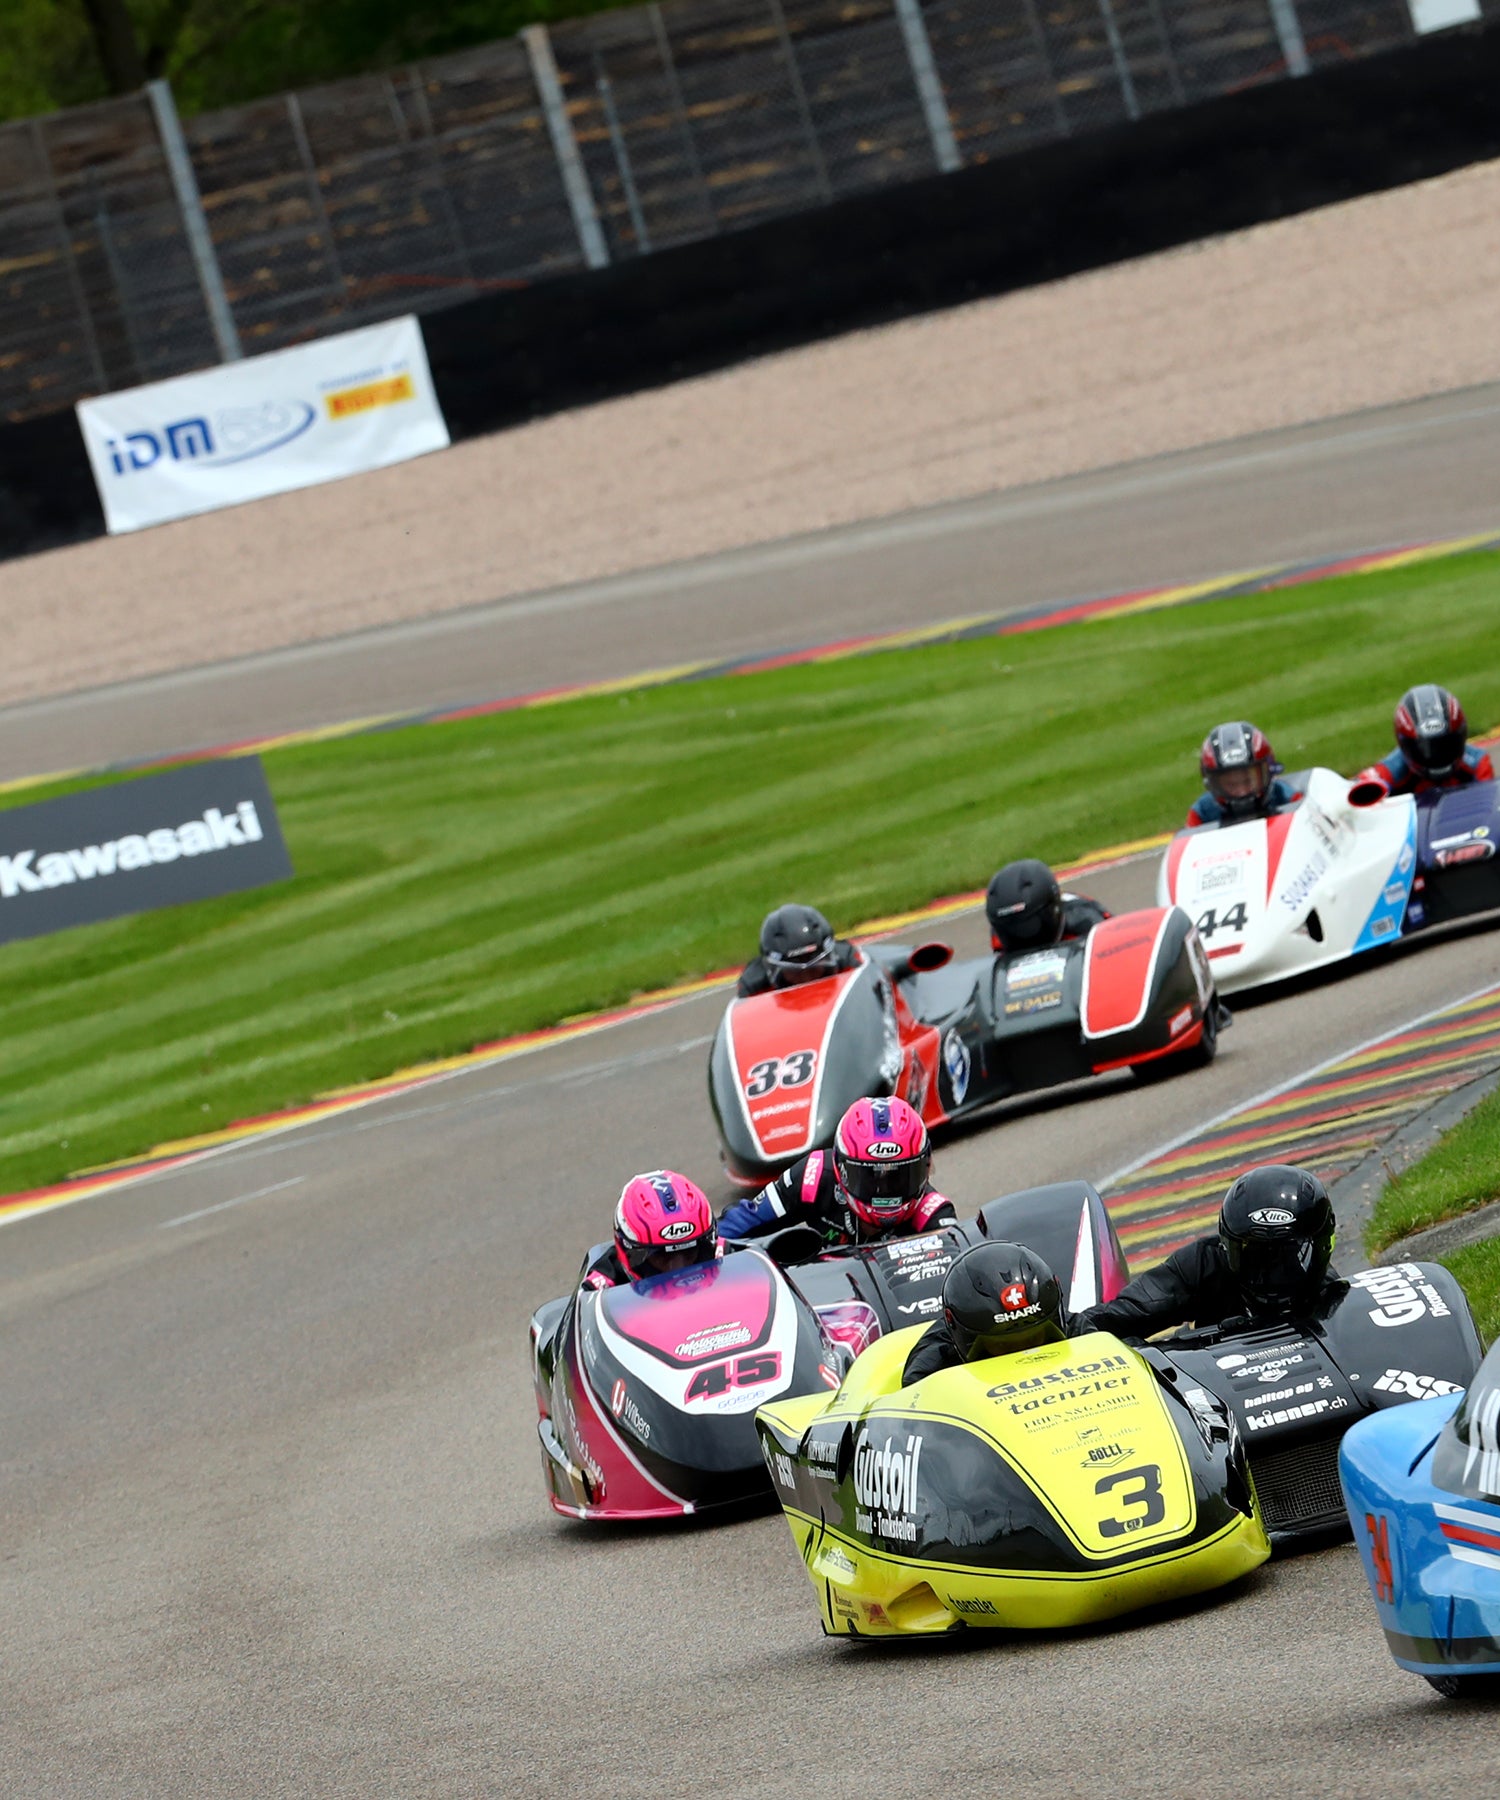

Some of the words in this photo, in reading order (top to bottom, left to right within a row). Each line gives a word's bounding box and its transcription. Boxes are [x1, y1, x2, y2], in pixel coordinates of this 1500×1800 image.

[0, 800, 264, 898] Kawasaki
[1196, 902, 1249, 939] 44
[745, 1048, 818, 1098] 33
[993, 1302, 1042, 1325] SHARK
[684, 1351, 782, 1406] 45
[985, 1355, 1128, 1399] Gustoil
[1235, 1354, 1304, 1377] daytona
[1008, 1375, 1132, 1415] taenzler
[1244, 1388, 1294, 1409] halltop
[1246, 1396, 1348, 1431] kiener.ch
[624, 1396, 650, 1439] Wilbers
[853, 1428, 923, 1515] Gustoil
[1095, 1464, 1165, 1538] 3
